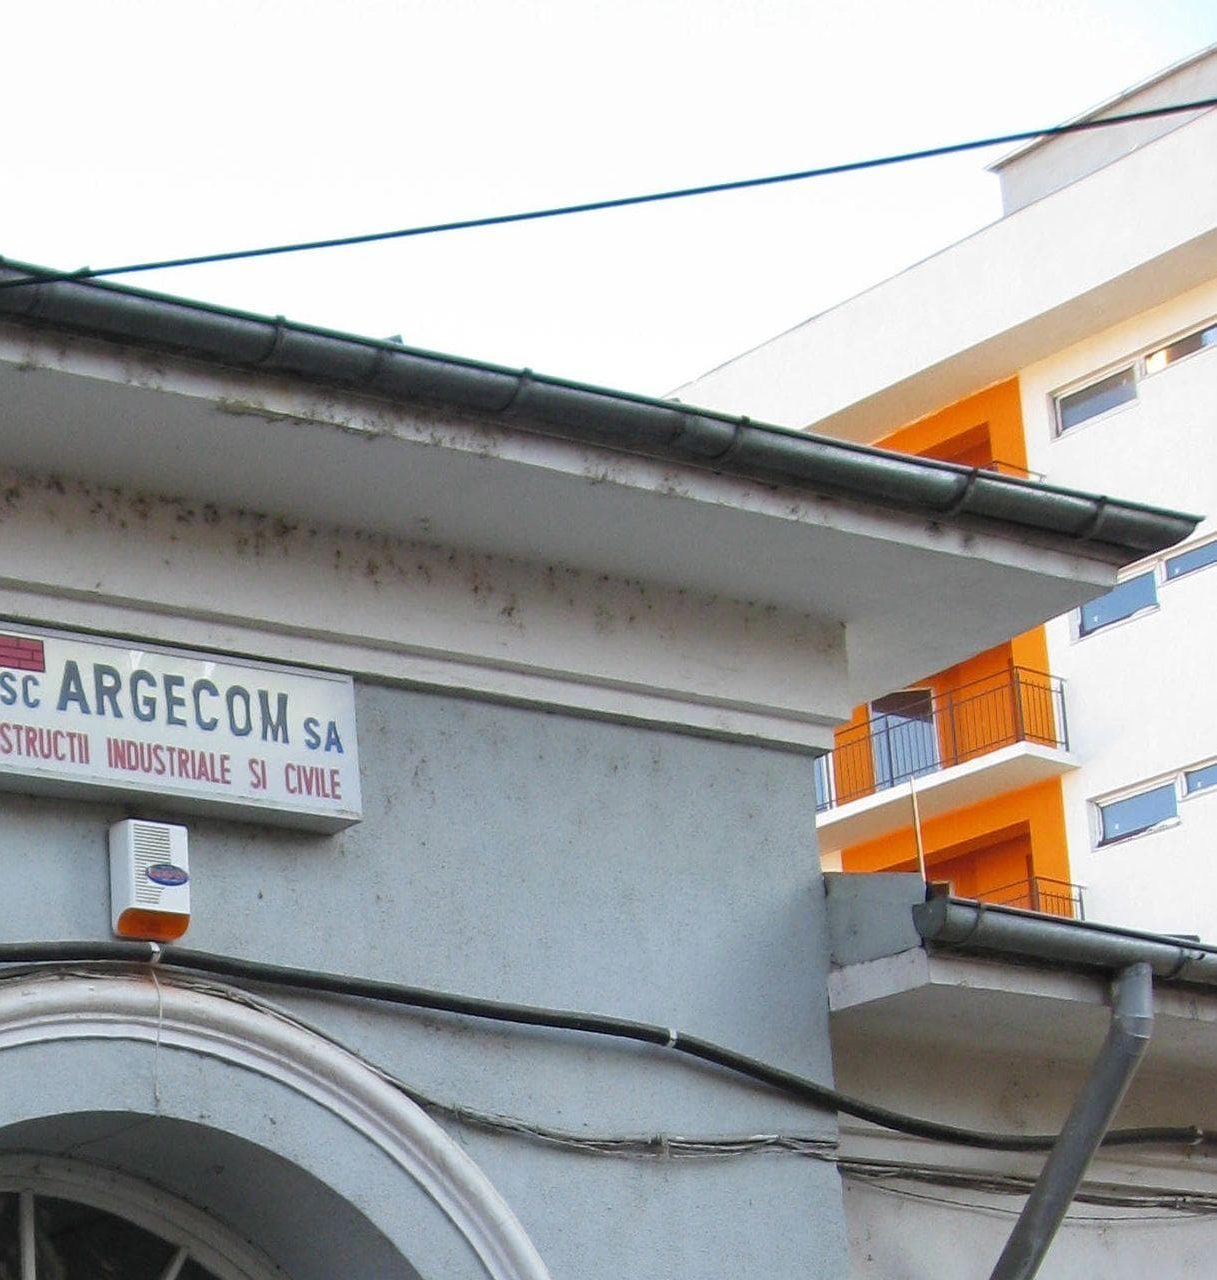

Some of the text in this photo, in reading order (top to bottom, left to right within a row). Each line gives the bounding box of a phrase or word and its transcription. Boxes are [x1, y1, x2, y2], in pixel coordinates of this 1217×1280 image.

[56, 660, 290, 744] ARGECOM
[304, 717, 344, 754] SA
[107, 737, 231, 785] INDUSTRIALE
[248, 758, 267, 791] SI
[284, 763, 342, 800] CIVILE
